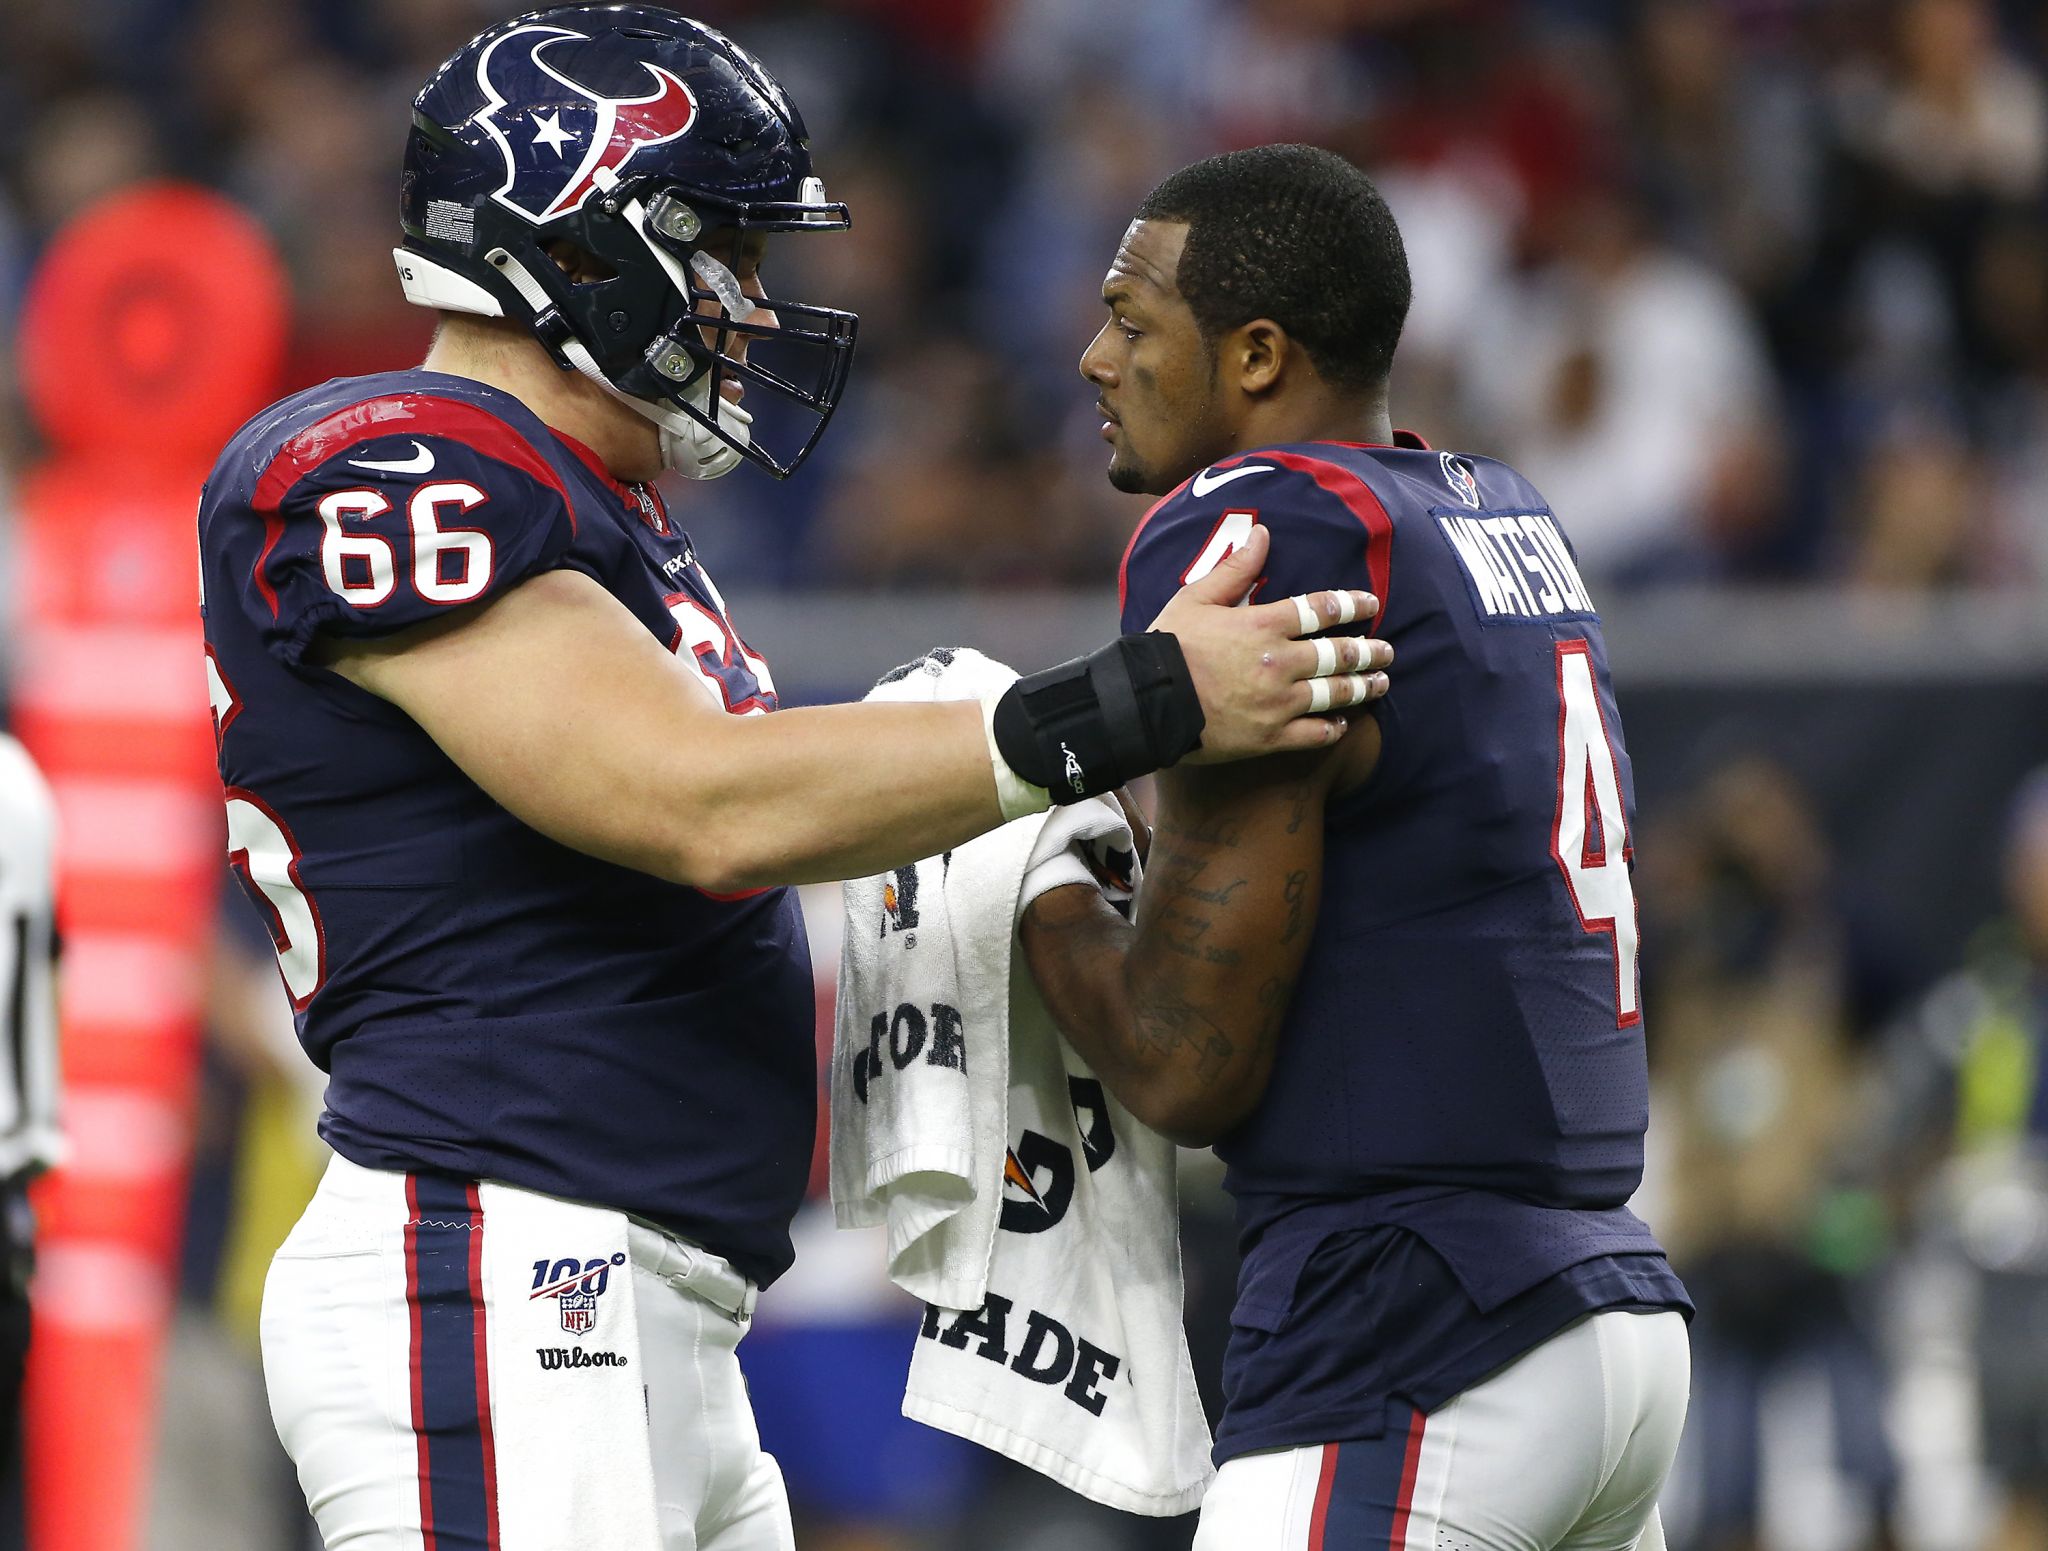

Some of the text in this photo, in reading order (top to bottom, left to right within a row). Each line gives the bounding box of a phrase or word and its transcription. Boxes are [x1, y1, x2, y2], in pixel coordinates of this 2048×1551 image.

[316, 481, 496, 609] 66
[1438, 515, 1596, 617] WATSON
[1550, 639, 1640, 1029] 4
[536, 1346, 619, 1370] Wilson
[564, 1311, 593, 1330] NFL
[921, 1291, 1121, 1418] ADE
